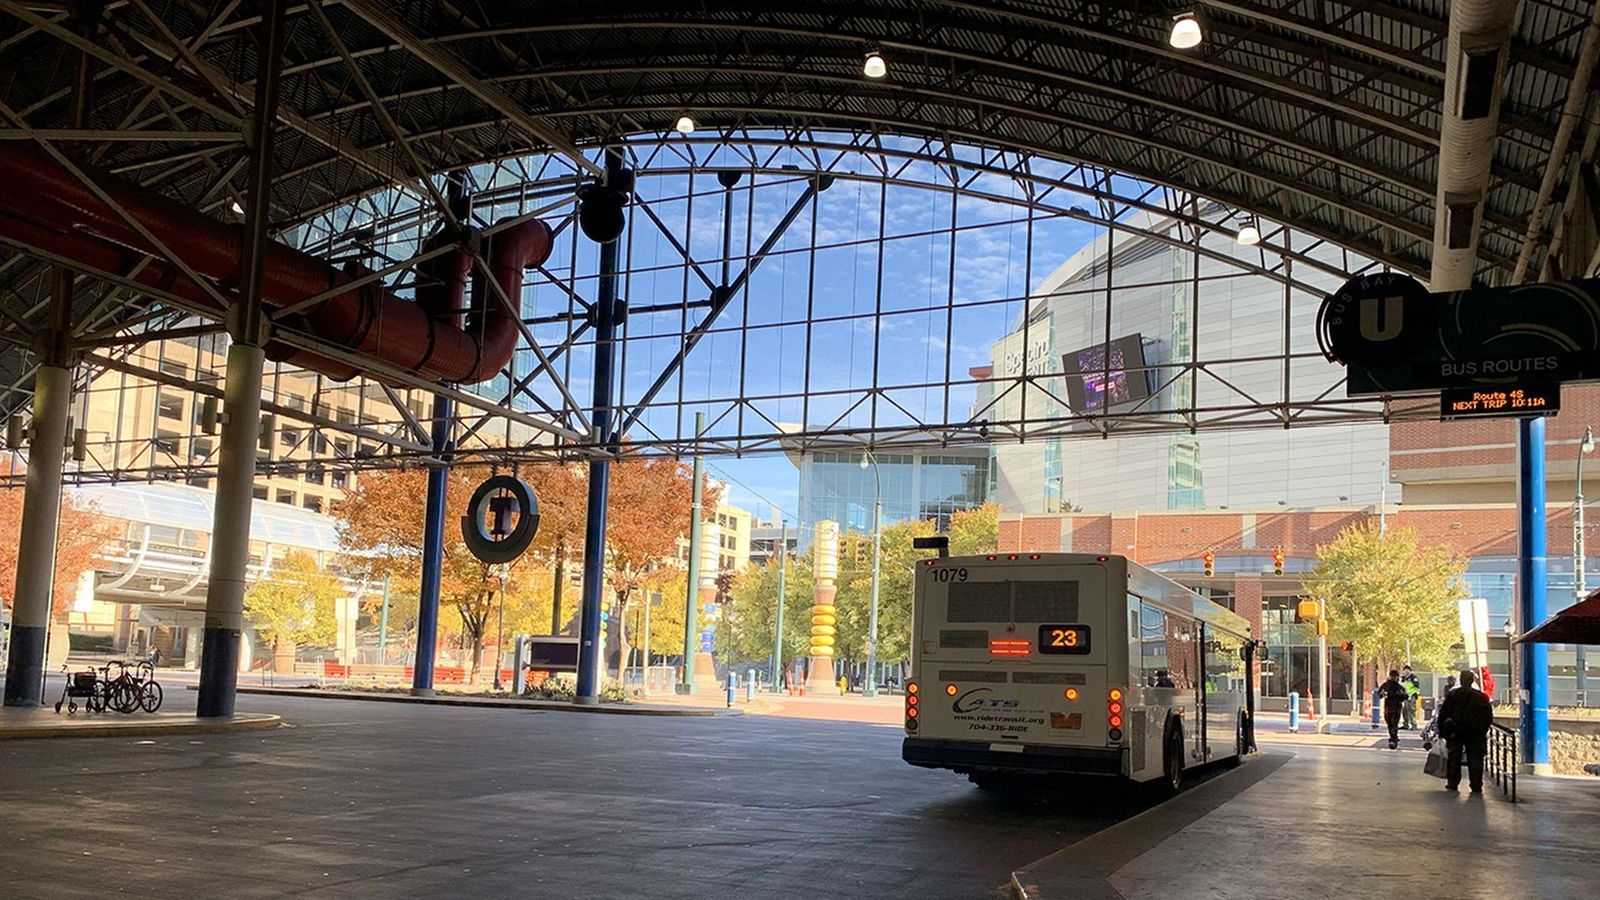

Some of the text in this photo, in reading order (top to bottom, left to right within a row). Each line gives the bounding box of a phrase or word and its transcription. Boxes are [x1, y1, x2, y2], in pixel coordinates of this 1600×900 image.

[1332, 276, 1395, 326] BUS BAY
[1360, 296, 1403, 341] U
[1441, 356, 1558, 376] BUS ROUTES
[1453, 397, 1546, 410] NEXT TRIP 10:11A
[1473, 392, 1506, 401] Route
[932, 568, 968, 583] 1079
[1051, 629, 1078, 647] 23
[953, 714, 1045, 725] www.ridetransit.org
